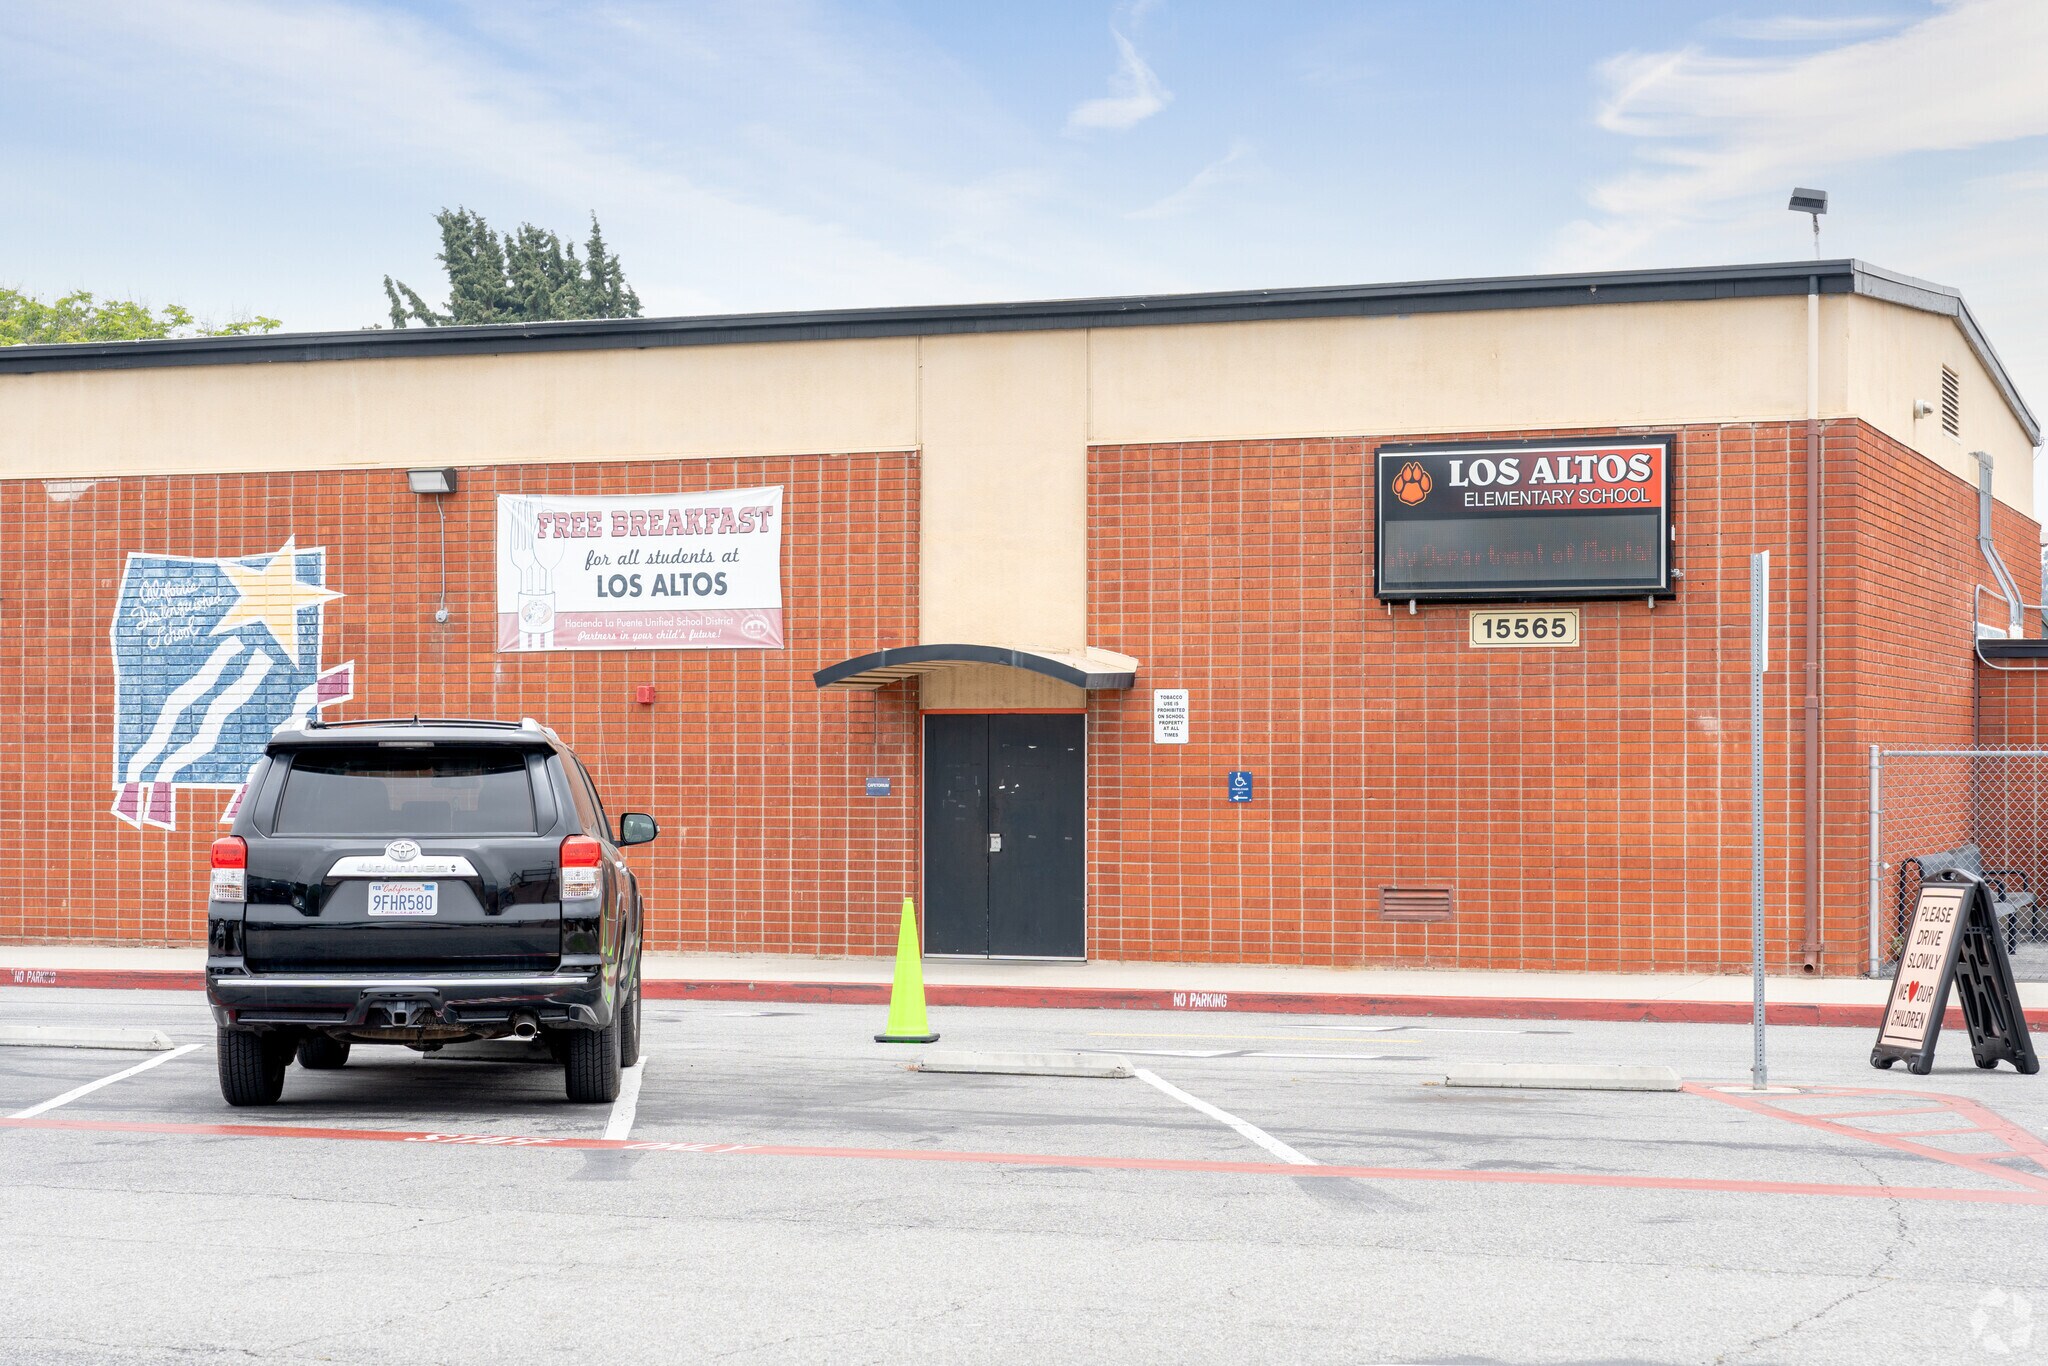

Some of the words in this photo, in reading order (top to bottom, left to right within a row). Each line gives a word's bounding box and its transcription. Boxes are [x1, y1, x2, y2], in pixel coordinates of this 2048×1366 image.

[1449, 457, 1521, 488] LOS
[1528, 453, 1653, 485] ALTOS
[1464, 489, 1575, 507] ELEMENTARY
[1578, 487, 1650, 504] SCHOOL
[537, 510, 602, 538] FREE
[611, 506, 774, 538] BREAKFAST
[585, 550, 611, 571] for
[617, 549, 640, 566] all
[645, 549, 715, 566] students
[721, 549, 740, 564] at
[597, 573, 643, 598] LOS
[651, 572, 728, 598] ALTOS
[148, 615, 202, 649] School
[564, 617, 603, 628] Hacienda
[605, 617, 614, 628] La
[616, 617, 643, 628] Puente
[645, 616, 674, 627] Unified
[676, 616, 703, 627] School
[705, 616, 733, 626] District
[1482, 617, 1567, 639] 15565
[577, 630, 617, 641] Partners
[619, 630, 630, 640] in
[632, 631, 653, 642] your
[656, 629, 686, 640] child's
[688, 628, 722, 641] future!
[383, 884, 425, 895] California
[373, 894, 433, 911] 9FHR580
[1920, 906, 1954, 923] PLEASE
[1916, 929, 1943, 946] DRIVE
[1907, 952, 1941, 970] SLOWLY
[14, 970, 24, 983] NO
[1173, 992, 1186, 1007] NO
[1190, 992, 1227, 1008] PARKING
[1897, 983, 1909, 1000] WE
[1916, 985, 1934, 1003] OUR
[1890, 1009, 1926, 1029] CHILDREN
[404, 1133, 568, 1146] STAFF
[623, 1142, 761, 1153] ONLY
